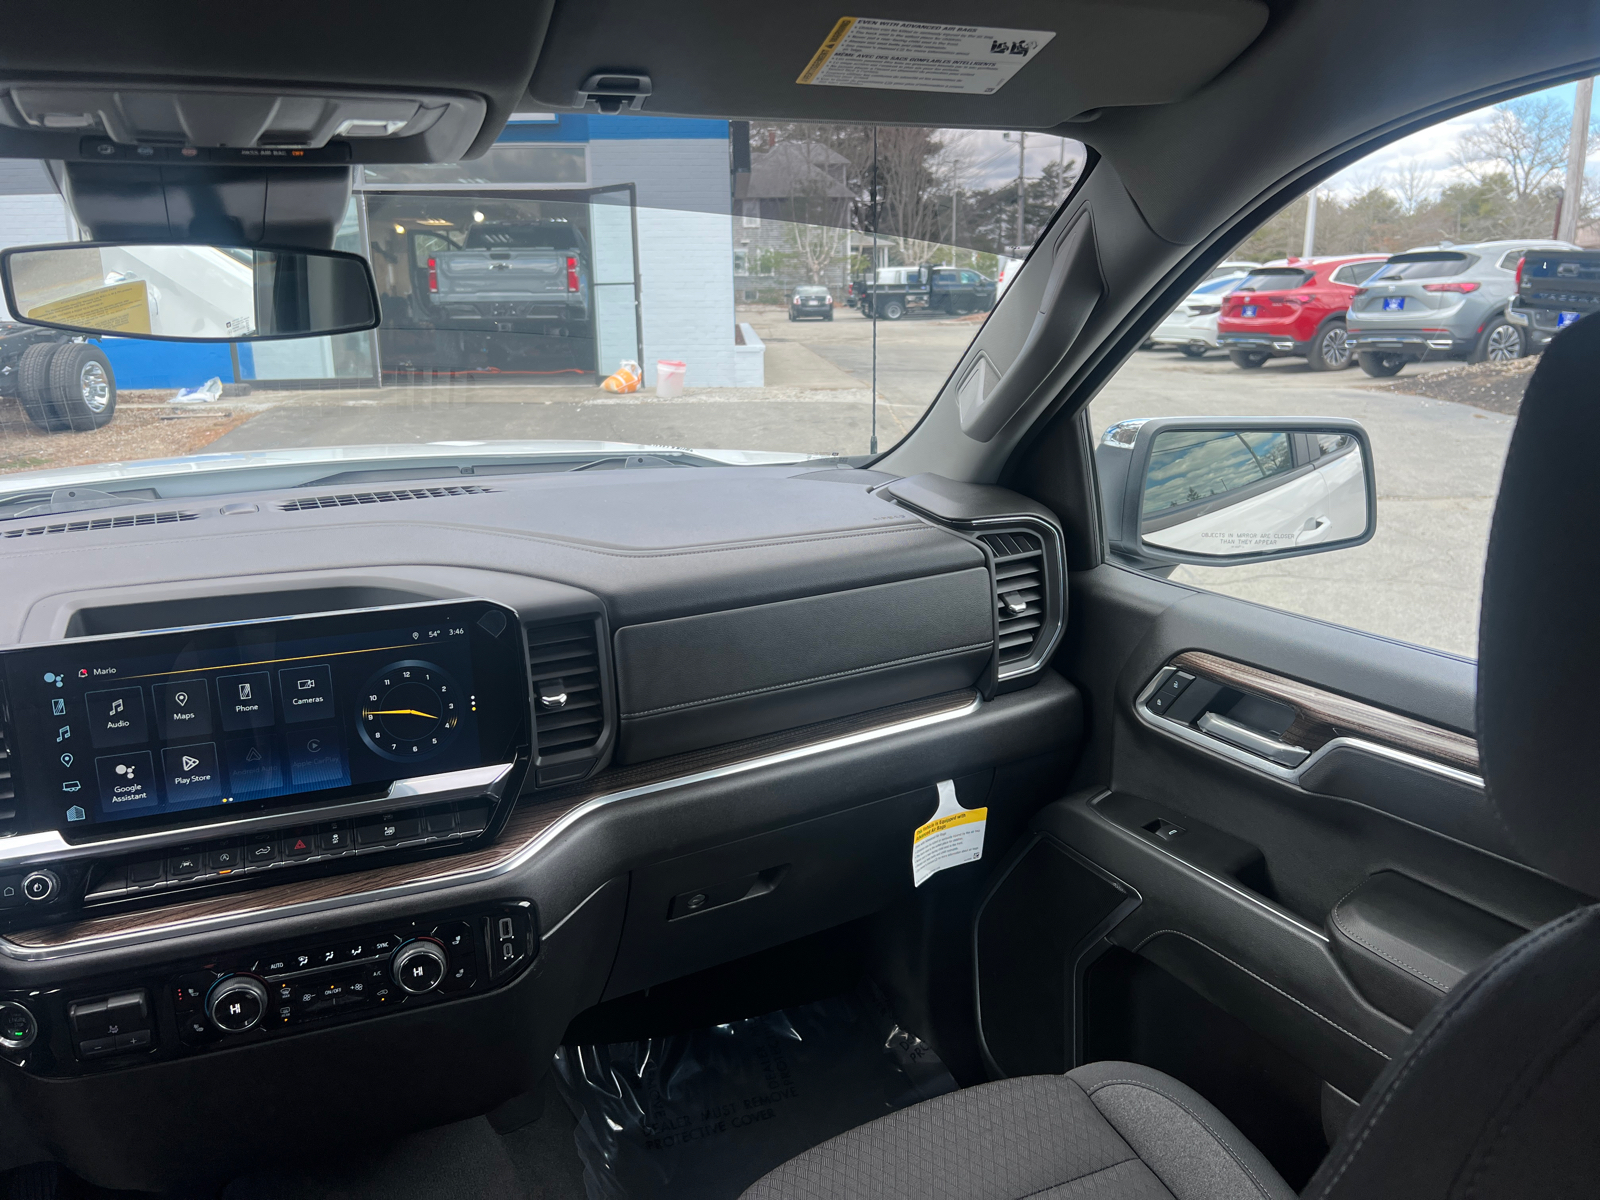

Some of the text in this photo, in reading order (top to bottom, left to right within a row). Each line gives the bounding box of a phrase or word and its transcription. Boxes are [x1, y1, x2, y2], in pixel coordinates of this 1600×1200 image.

[428, 628, 464, 638] 54° 3:46
[93, 667, 117, 676] Mario
[292, 697, 324, 705] Cameras
[235, 704, 259, 712] Phone
[173, 712, 195, 720] Maps
[107, 720, 130, 729] Audio
[313, 756, 339, 765] CarPlay
[233, 767, 260, 776] Android
[174, 774, 211, 785] Play Store
[114, 783, 142, 794] Google
[111, 792, 147, 803] Assistant
[939, 816, 957, 826] Equipped
[412, 966, 424, 977] HI
[324, 987, 342, 996] ON/OFF
[229, 1002, 241, 1015] HI
[642, 1087, 799, 1137] DEALER MUST REMOVE
[645, 1108, 777, 1150] PROTECTIVE COVER
